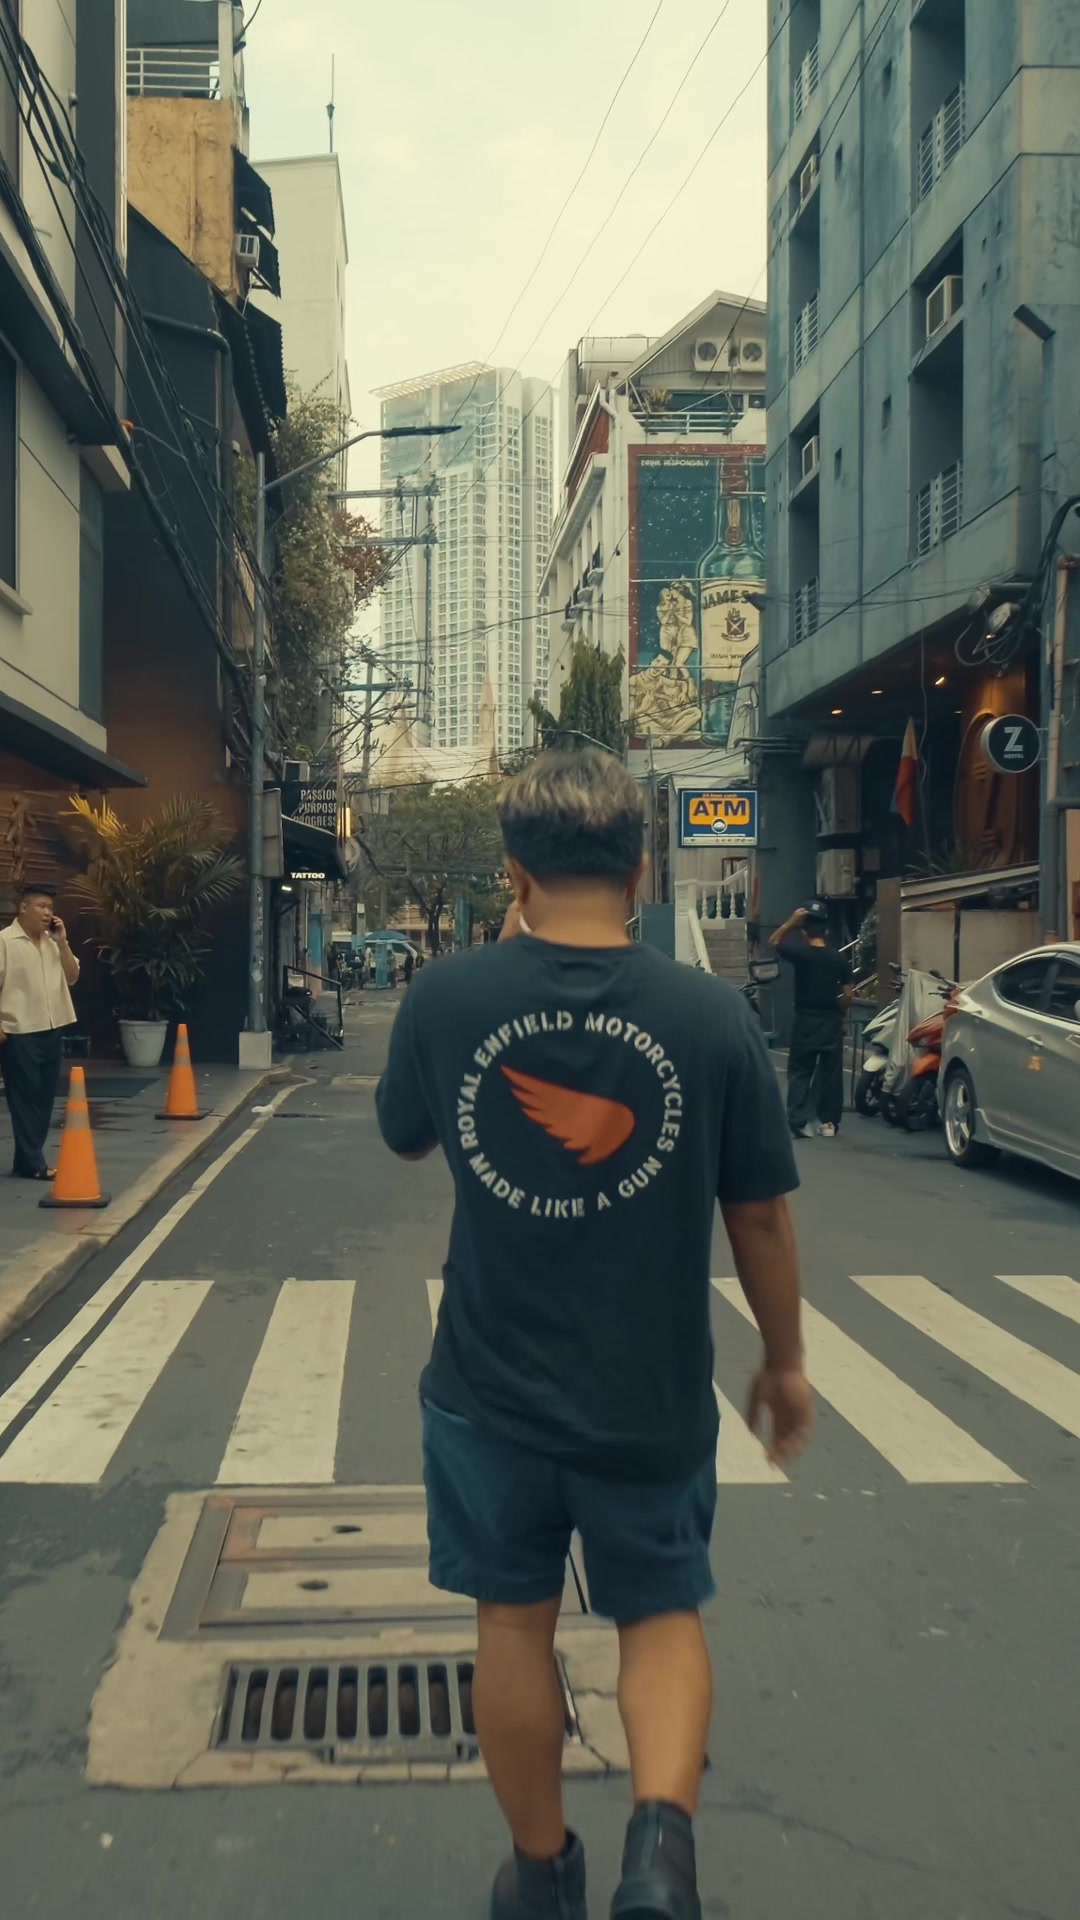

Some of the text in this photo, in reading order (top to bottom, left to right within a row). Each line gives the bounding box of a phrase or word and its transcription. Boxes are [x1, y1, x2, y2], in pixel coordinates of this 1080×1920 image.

[703, 590, 760, 610] JAMES
[1003, 726, 1024, 752] Z
[300, 789, 337, 801] PASSION
[693, 800, 746, 816] ATM
[457, 1010, 683, 1153] ROYAL ENFIELD MOTORCYCLES
[469, 1152, 663, 1218] MADE LIKE A GUN
